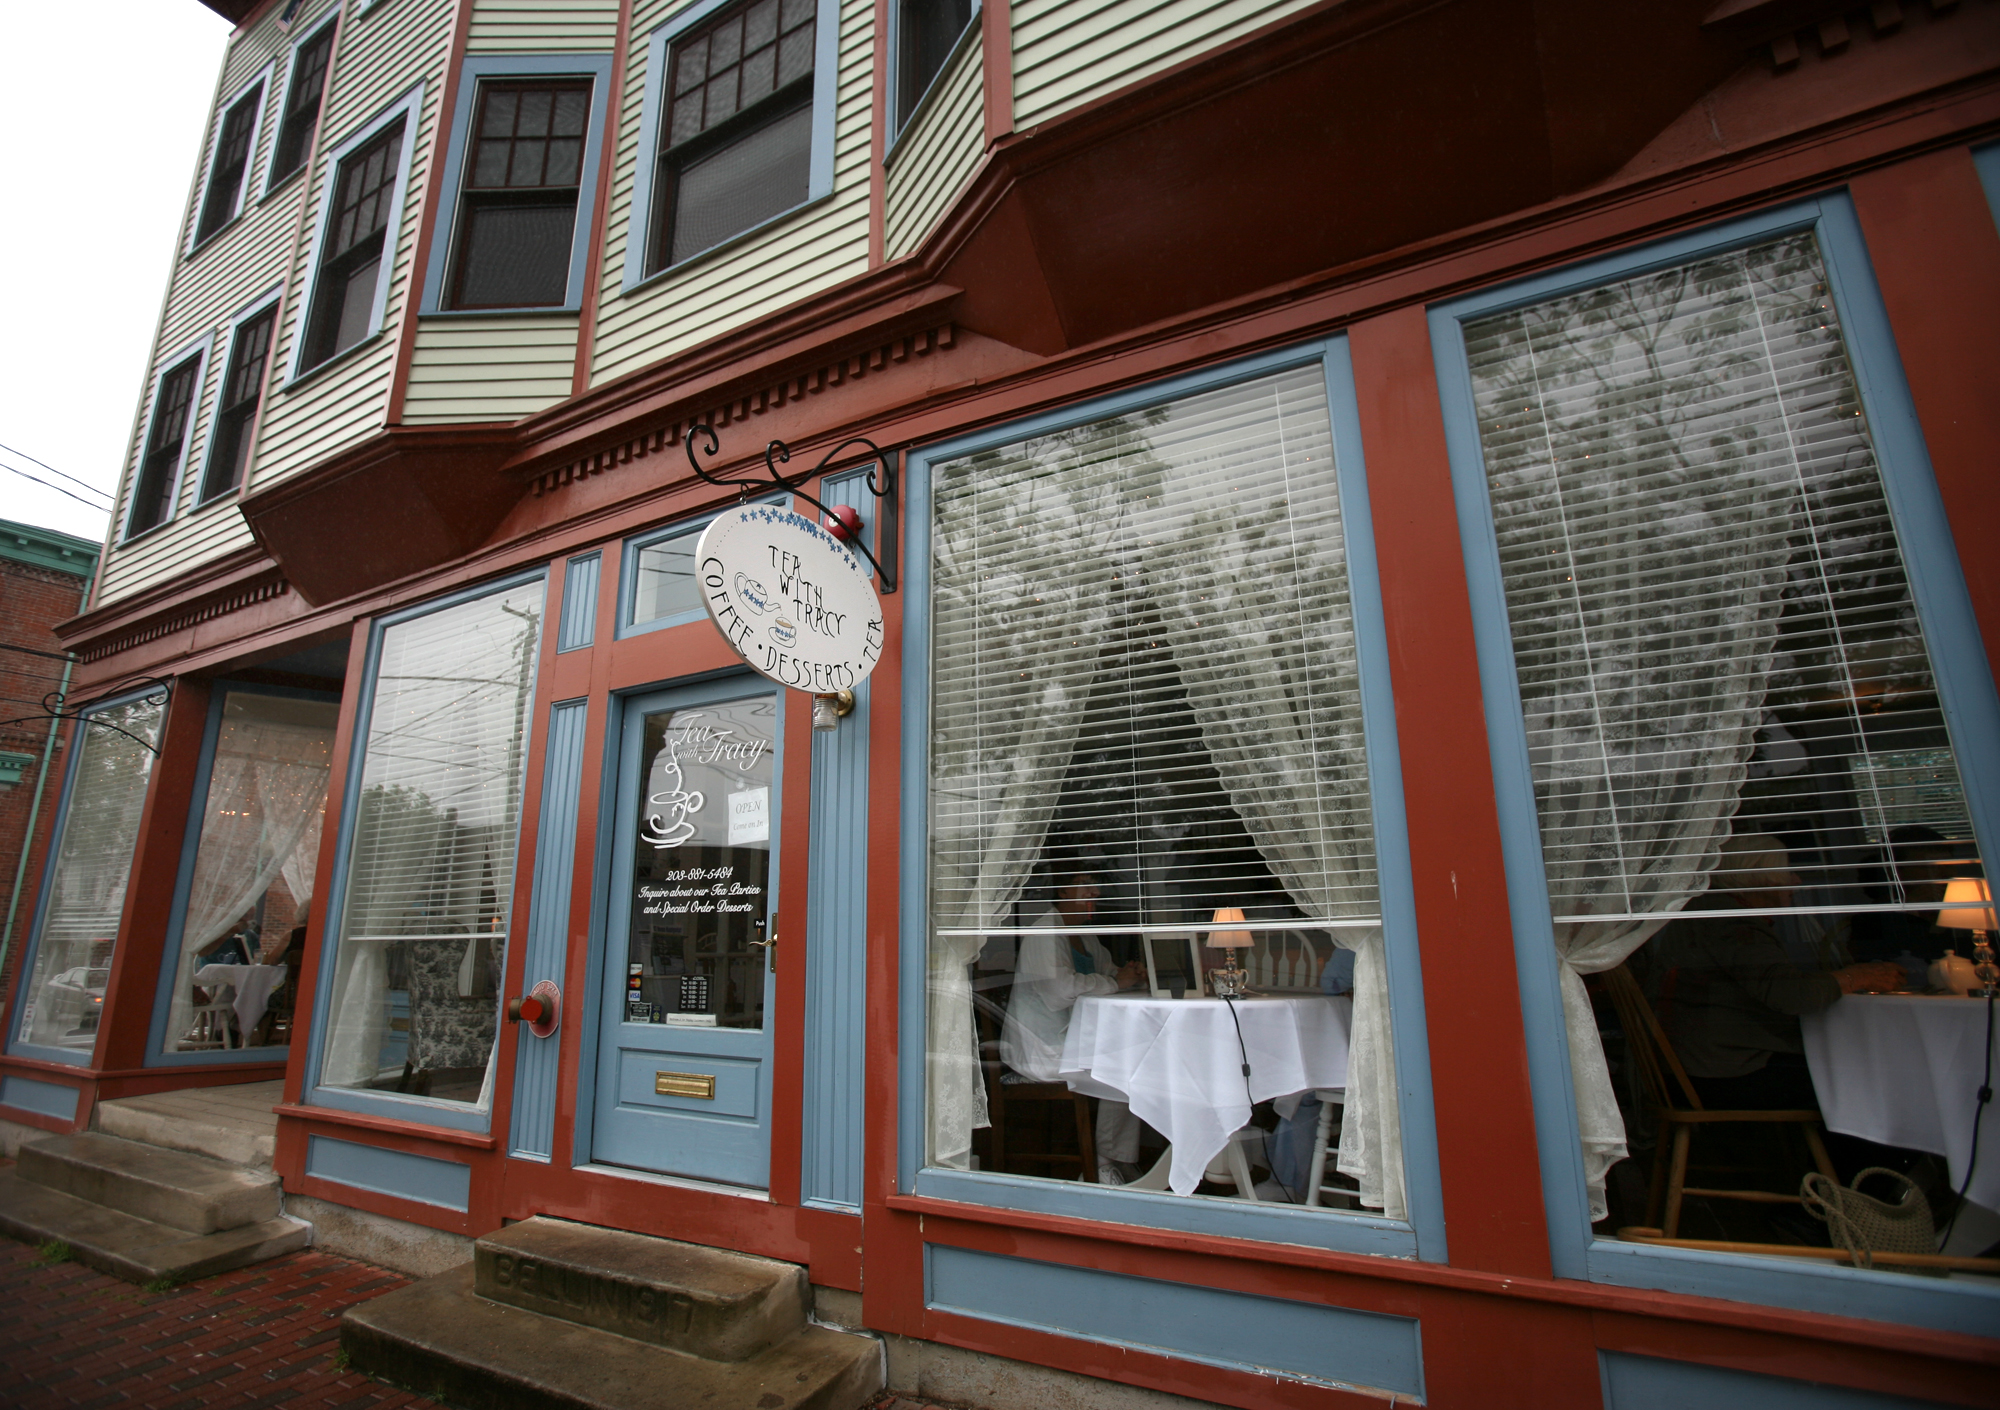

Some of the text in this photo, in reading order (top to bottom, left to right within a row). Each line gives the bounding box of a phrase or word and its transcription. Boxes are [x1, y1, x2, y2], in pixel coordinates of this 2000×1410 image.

[768, 545, 804, 584] TEA
[779, 574, 826, 613] WITH
[702, 557, 884, 691] COFFEE DESSERTS TEA
[793, 599, 846, 638] TRACY
[674, 713, 711, 744] Tea
[677, 744, 698, 760] with
[698, 731, 767, 771] Tracy
[735, 800, 762, 815] OPEN
[638, 882, 761, 902] Inquire about our Tea Parties
[643, 899, 753, 918] and Special Order Desserts
